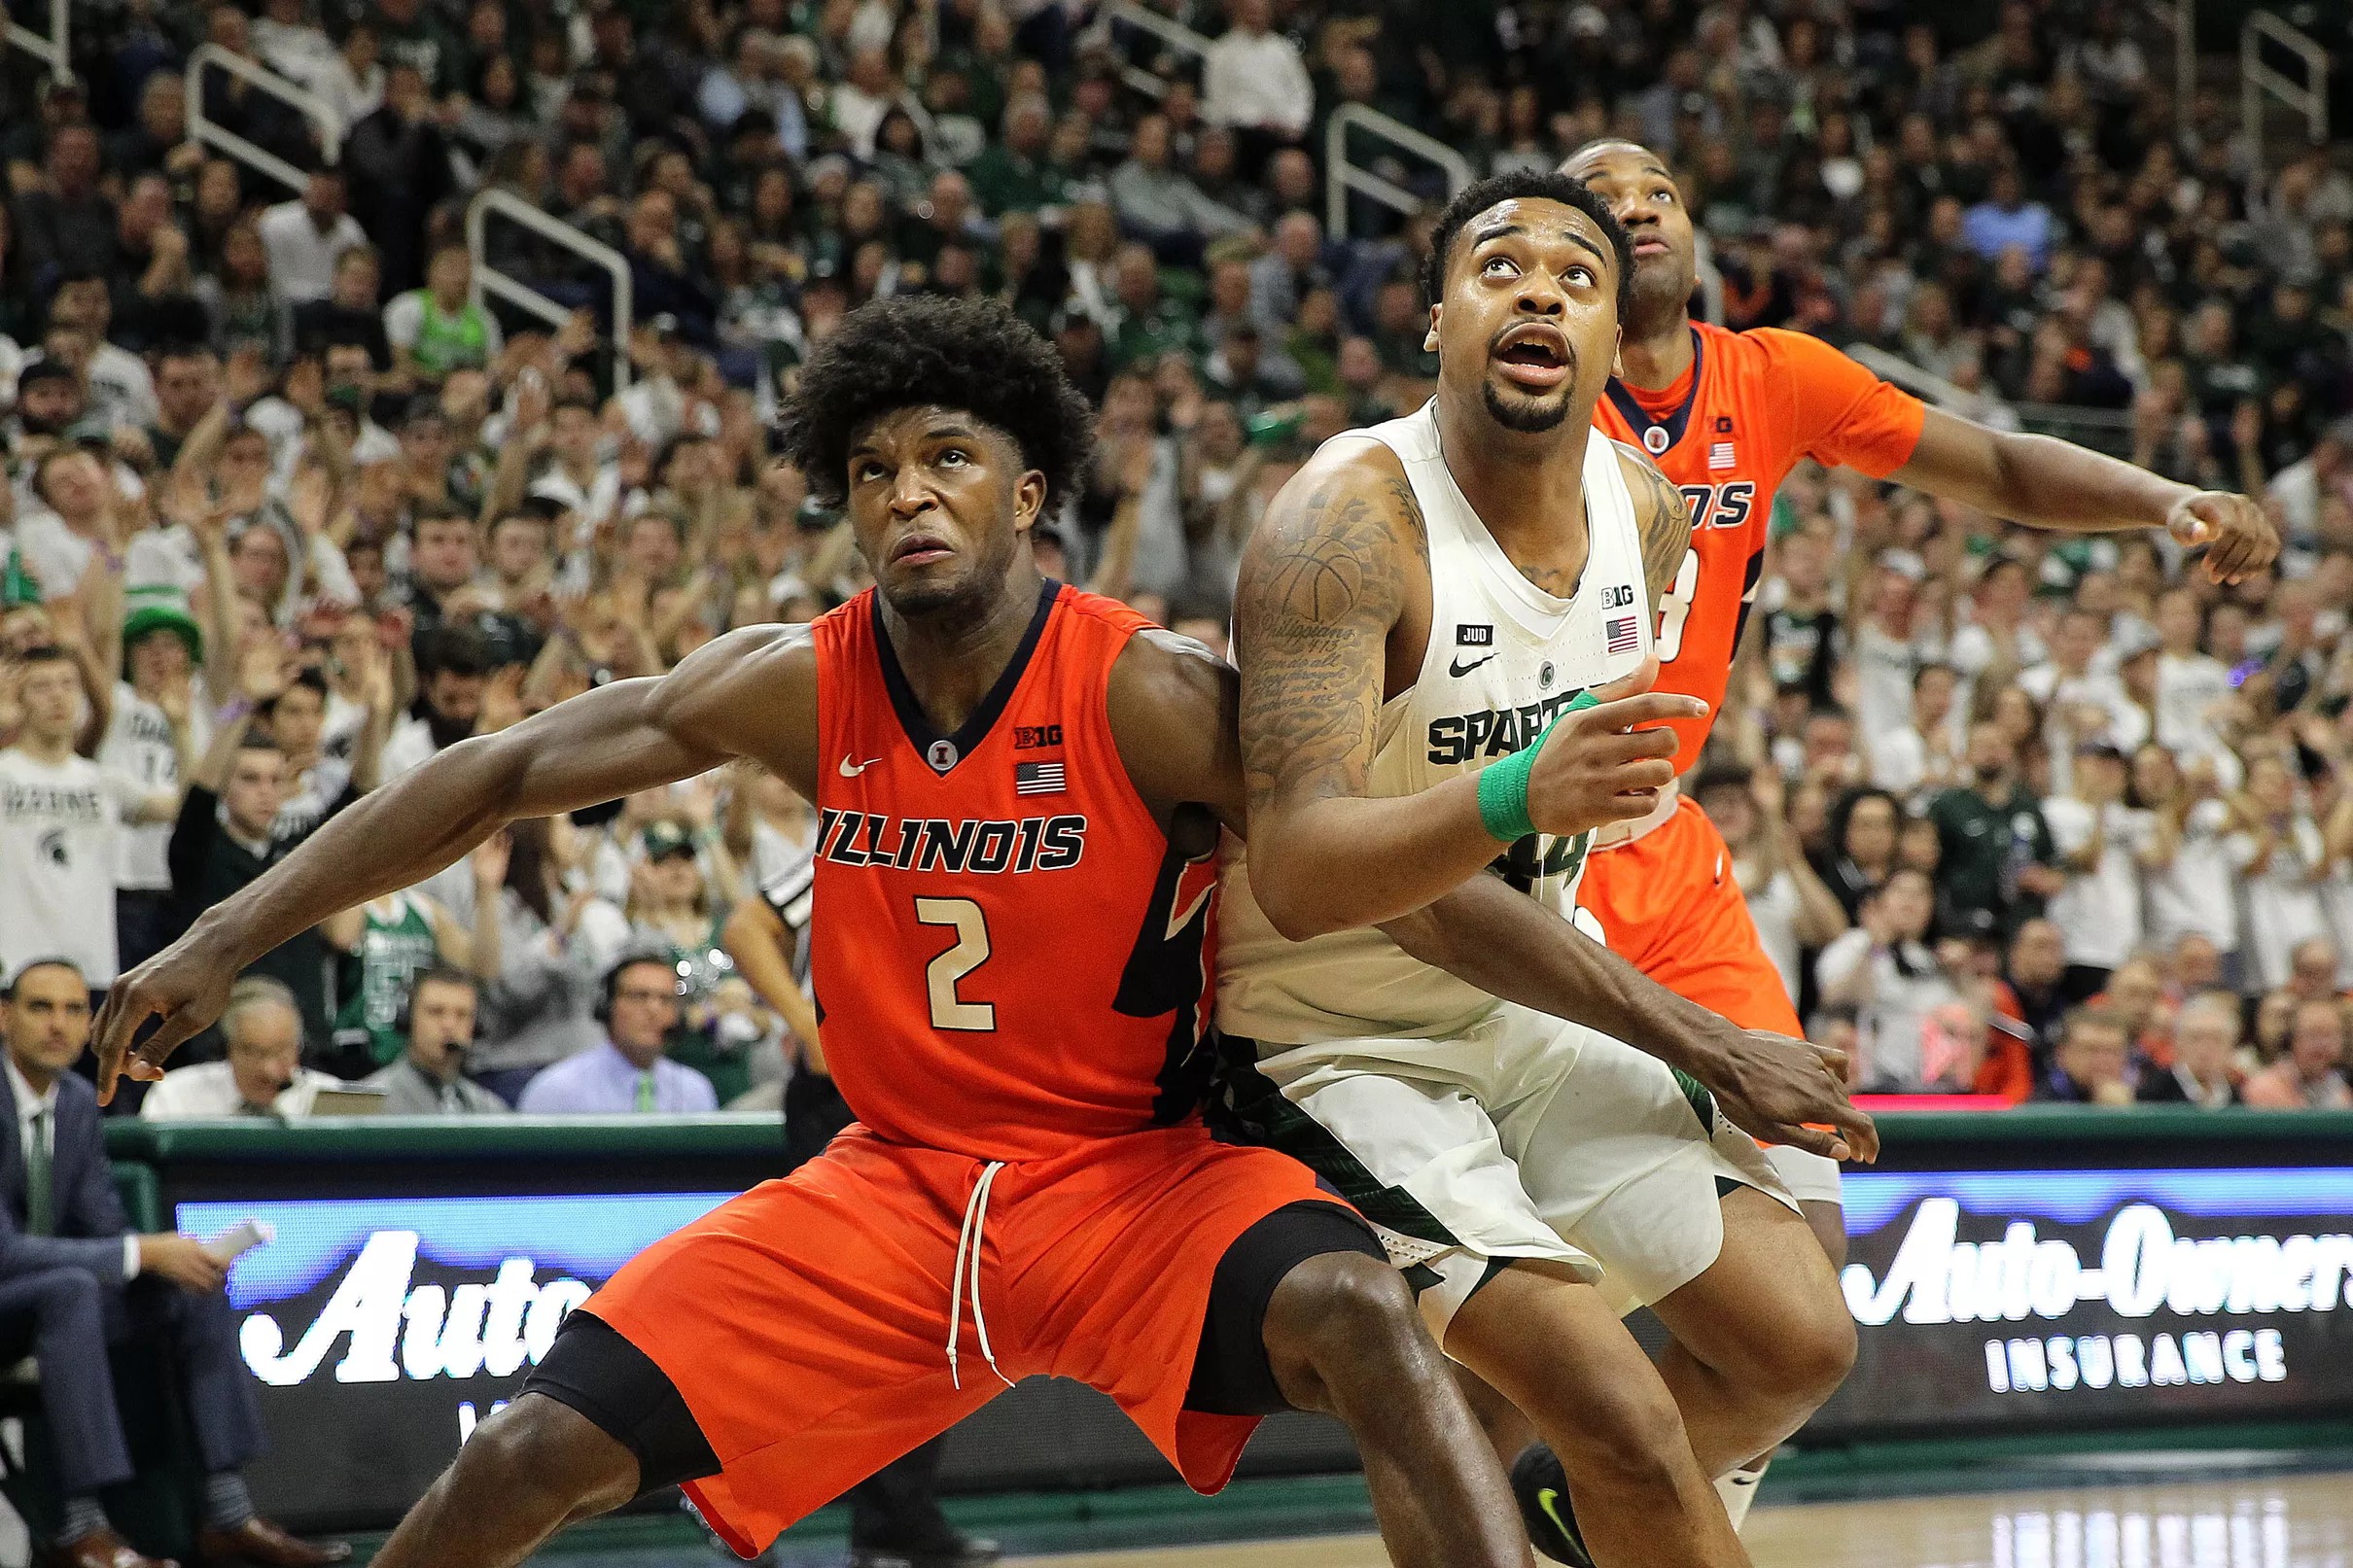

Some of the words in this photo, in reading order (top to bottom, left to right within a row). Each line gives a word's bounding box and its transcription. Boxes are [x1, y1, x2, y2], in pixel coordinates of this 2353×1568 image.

[1462, 627, 1488, 643] JUD
[1427, 683, 1607, 765] SPART
[814, 806, 1087, 874] ILLINOIS
[914, 895, 997, 1031] 2
[1841, 1198, 2353, 1325] Auto-Owner
[1984, 1329, 2288, 1393] INSURANCE
